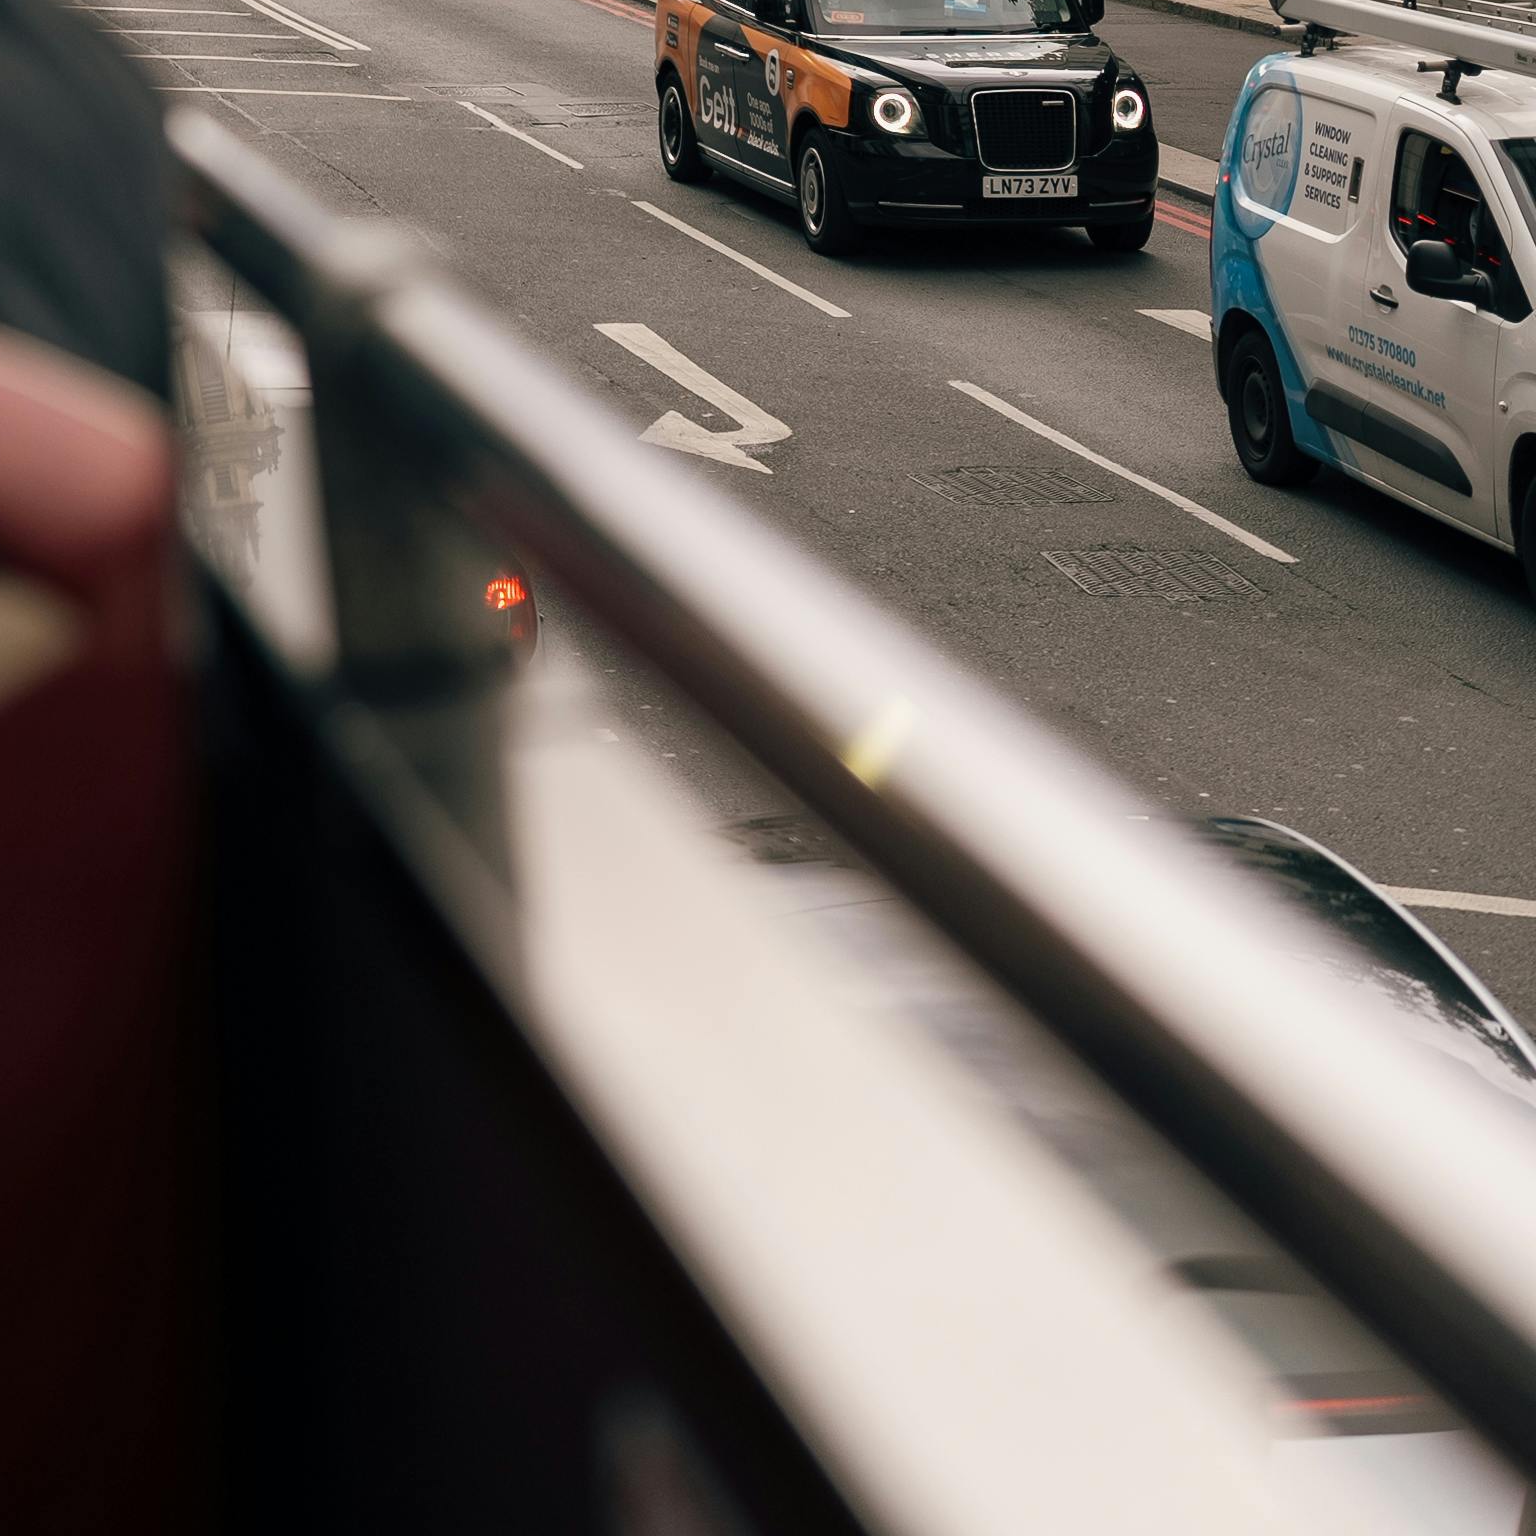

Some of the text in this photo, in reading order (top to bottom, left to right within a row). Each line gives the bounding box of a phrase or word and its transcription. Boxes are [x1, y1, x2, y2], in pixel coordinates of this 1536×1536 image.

[699, 74, 737, 136] Gett
[746, 91, 760, 109] One
[749, 111, 774, 134] 1000s of
[1314, 121, 1352, 145] WINDOW
[746, 129, 765, 149] black
[1242, 122, 1292, 171] Crystal
[1309, 142, 1349, 167] CLEANING
[990, 178, 1071, 194] LN73 ZYV
[1304, 162, 1348, 189] & SUPPORT
[1304, 184, 1342, 210] SERVICES
[1348, 324, 1416, 368] 01375 370800
[1325, 344, 1447, 409] www.crystalclearuk.net
